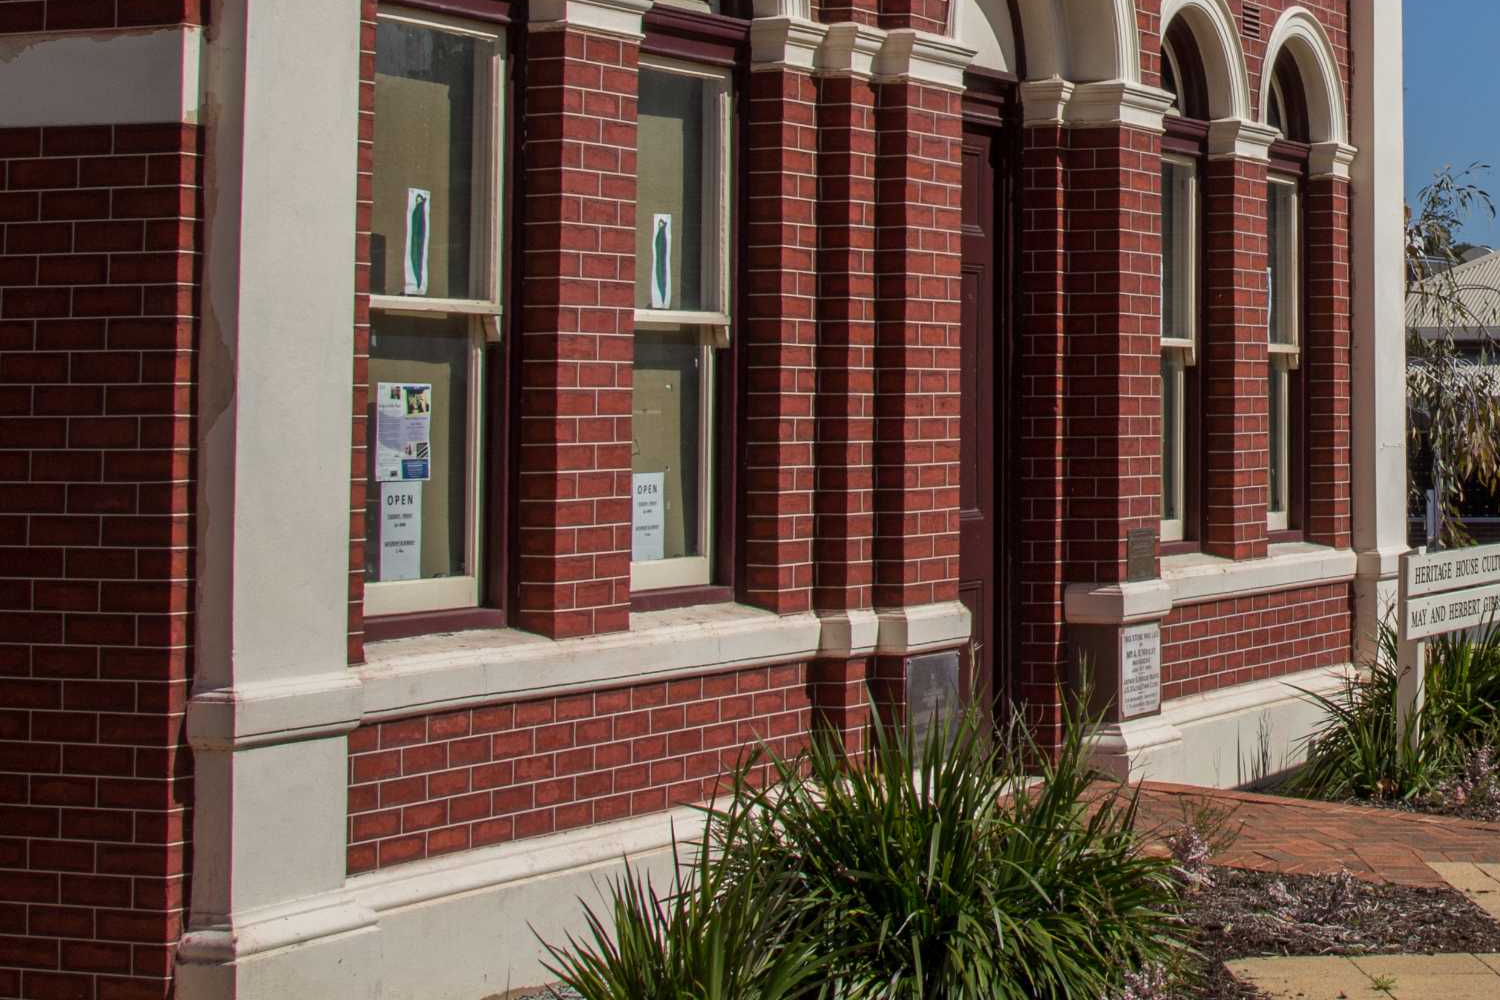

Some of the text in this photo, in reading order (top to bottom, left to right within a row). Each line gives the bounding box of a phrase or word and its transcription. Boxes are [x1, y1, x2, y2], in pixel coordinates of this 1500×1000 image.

[637, 484, 657, 494] OPEN
[387, 495, 413, 505] OPEN
[1415, 562, 1452, 584] HERITAGE
[1455, 558, 1479, 577] HOUSE
[1411, 608, 1428, 628] MAY
[1430, 605, 1446, 623] AND
[1449, 598, 1481, 620] HERBERT
